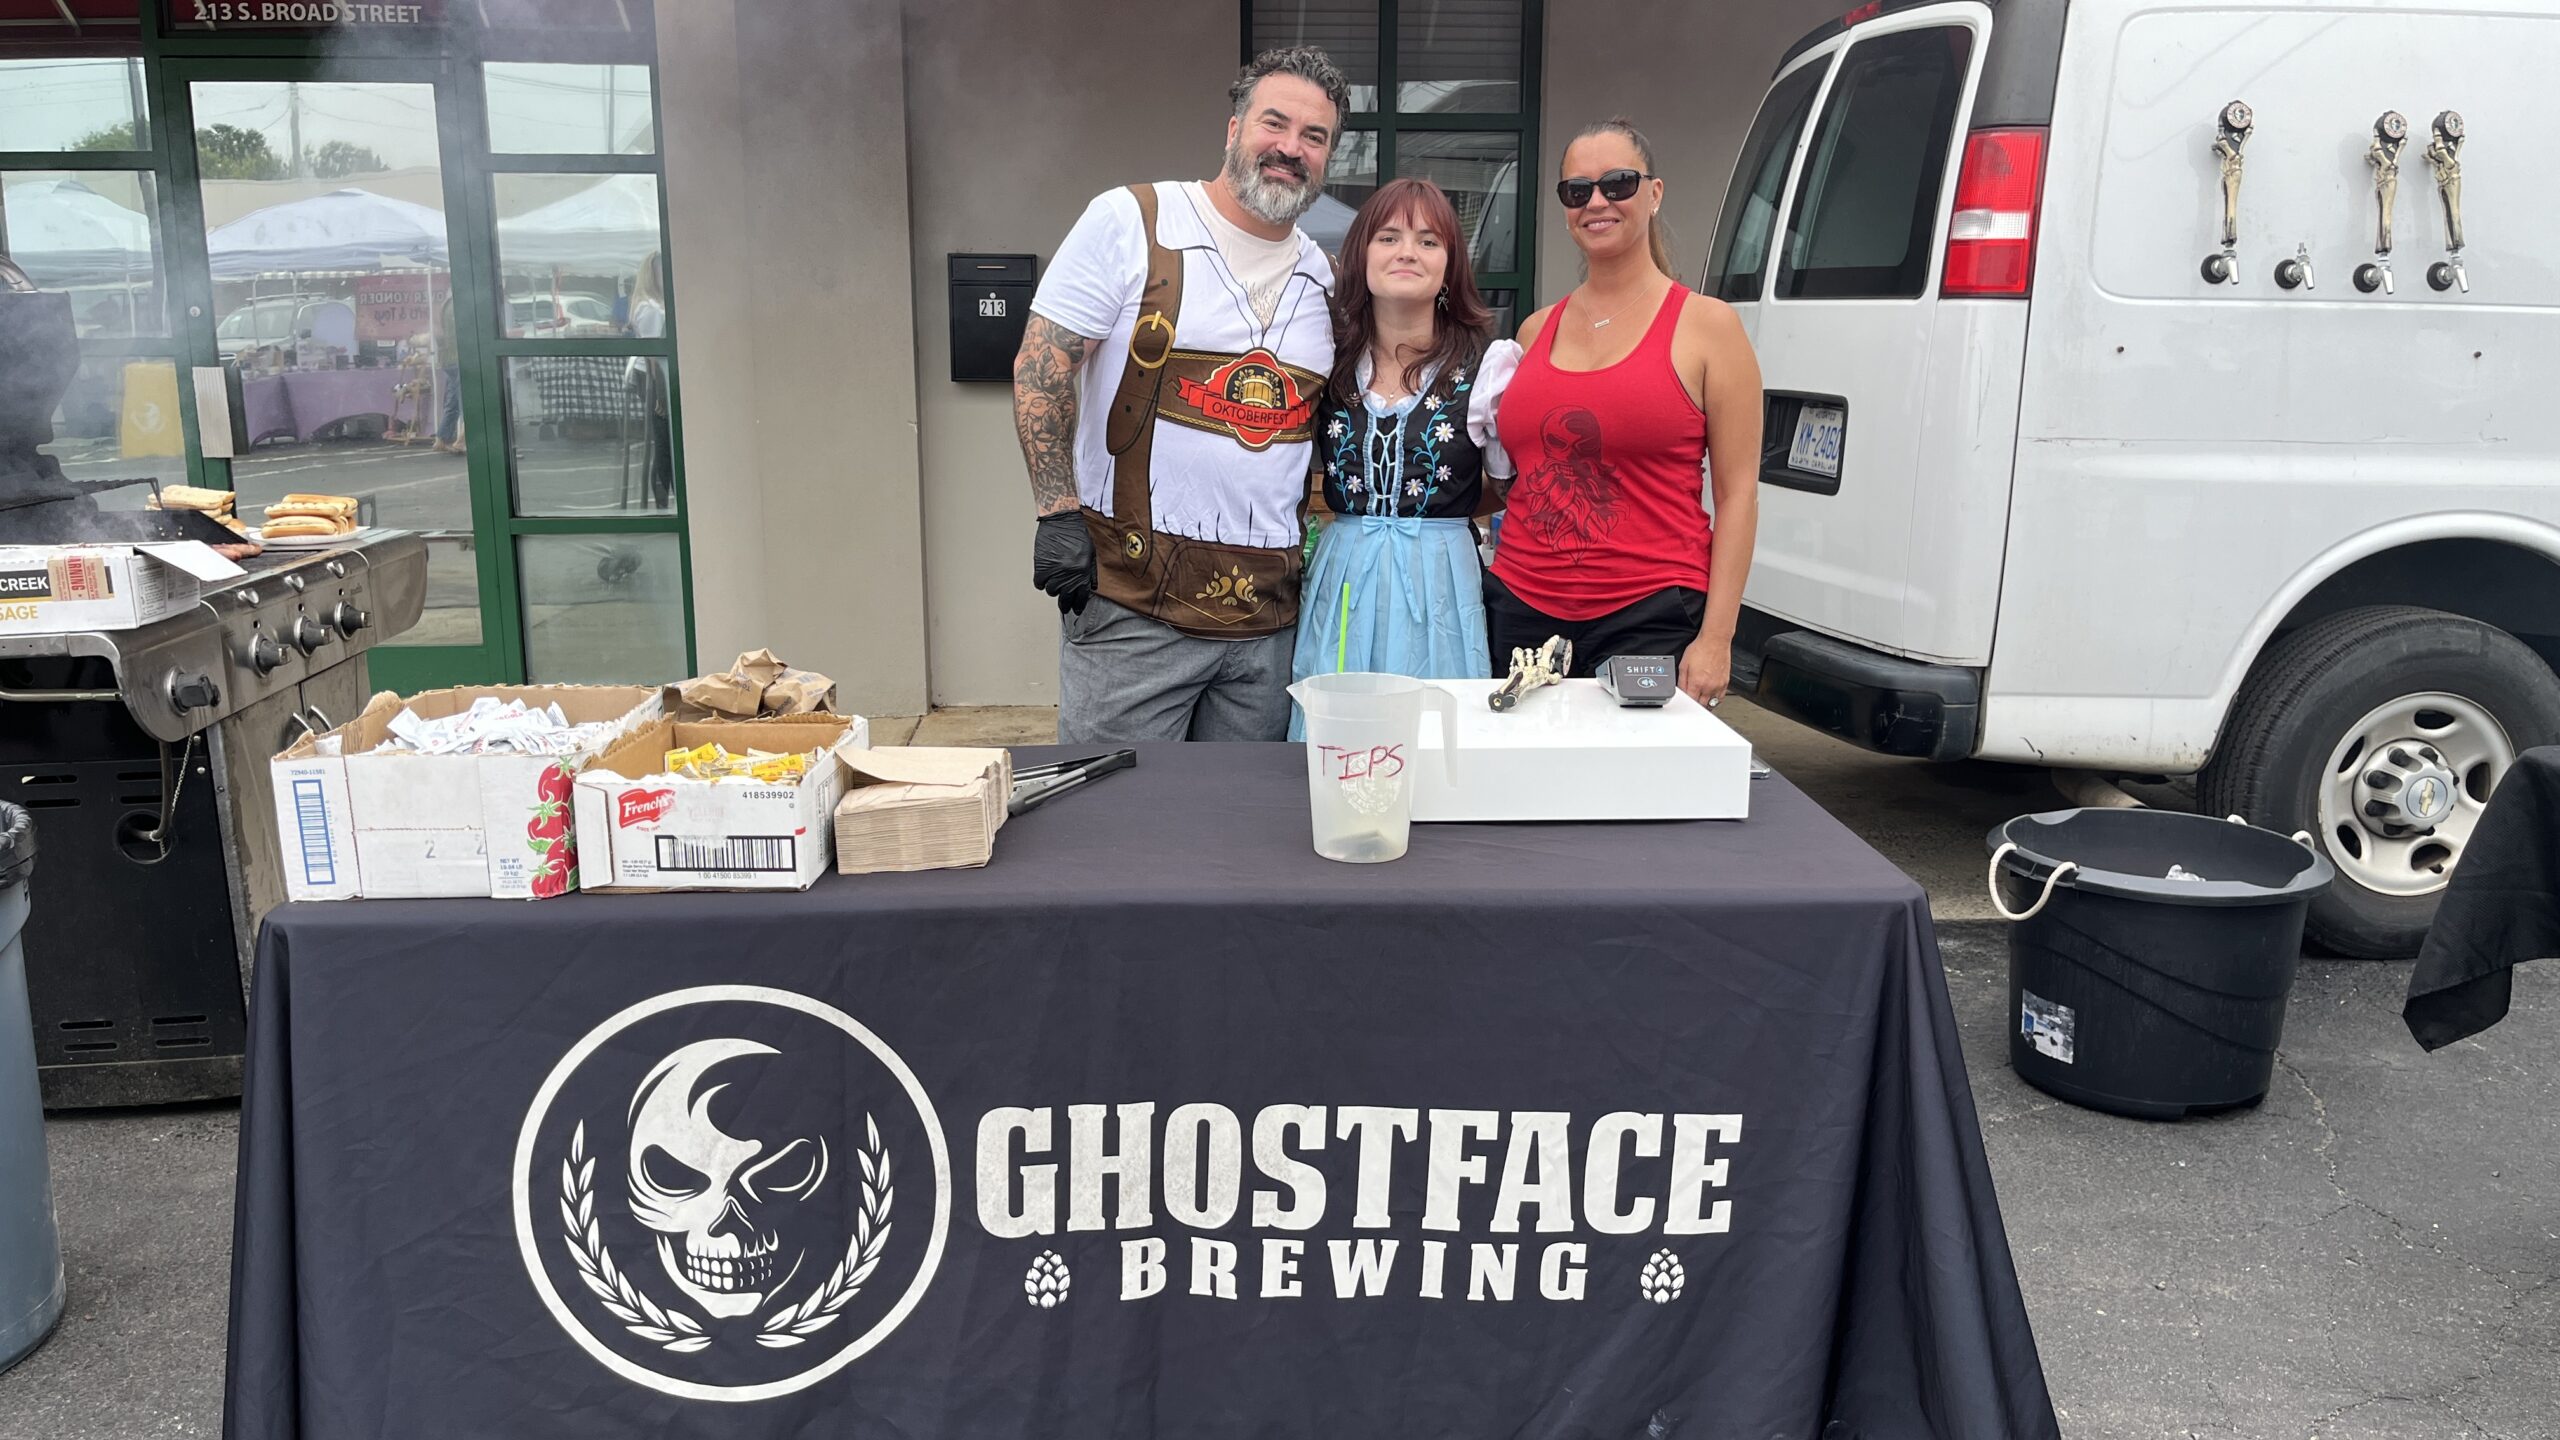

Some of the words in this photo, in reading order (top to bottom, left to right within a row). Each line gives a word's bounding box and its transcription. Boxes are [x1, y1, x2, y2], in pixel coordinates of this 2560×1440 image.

[194, 3, 232, 21] 213
[238, 3, 257, 21] S.
[262, 3, 338, 22] BROAD
[342, 4, 422, 23] STREET
[981, 301, 1004, 315] 213
[1212, 401, 1290, 425] OKTOBERFEST
[0, 576, 49, 591] CREEK
[1317, 743, 1404, 780] TIPS
[623, 794, 669, 817] French's
[742, 791, 795, 799] 418539902
[975, 1101, 1743, 1239] GHOSTFACE
[1119, 1236, 1589, 1301] BREWING
